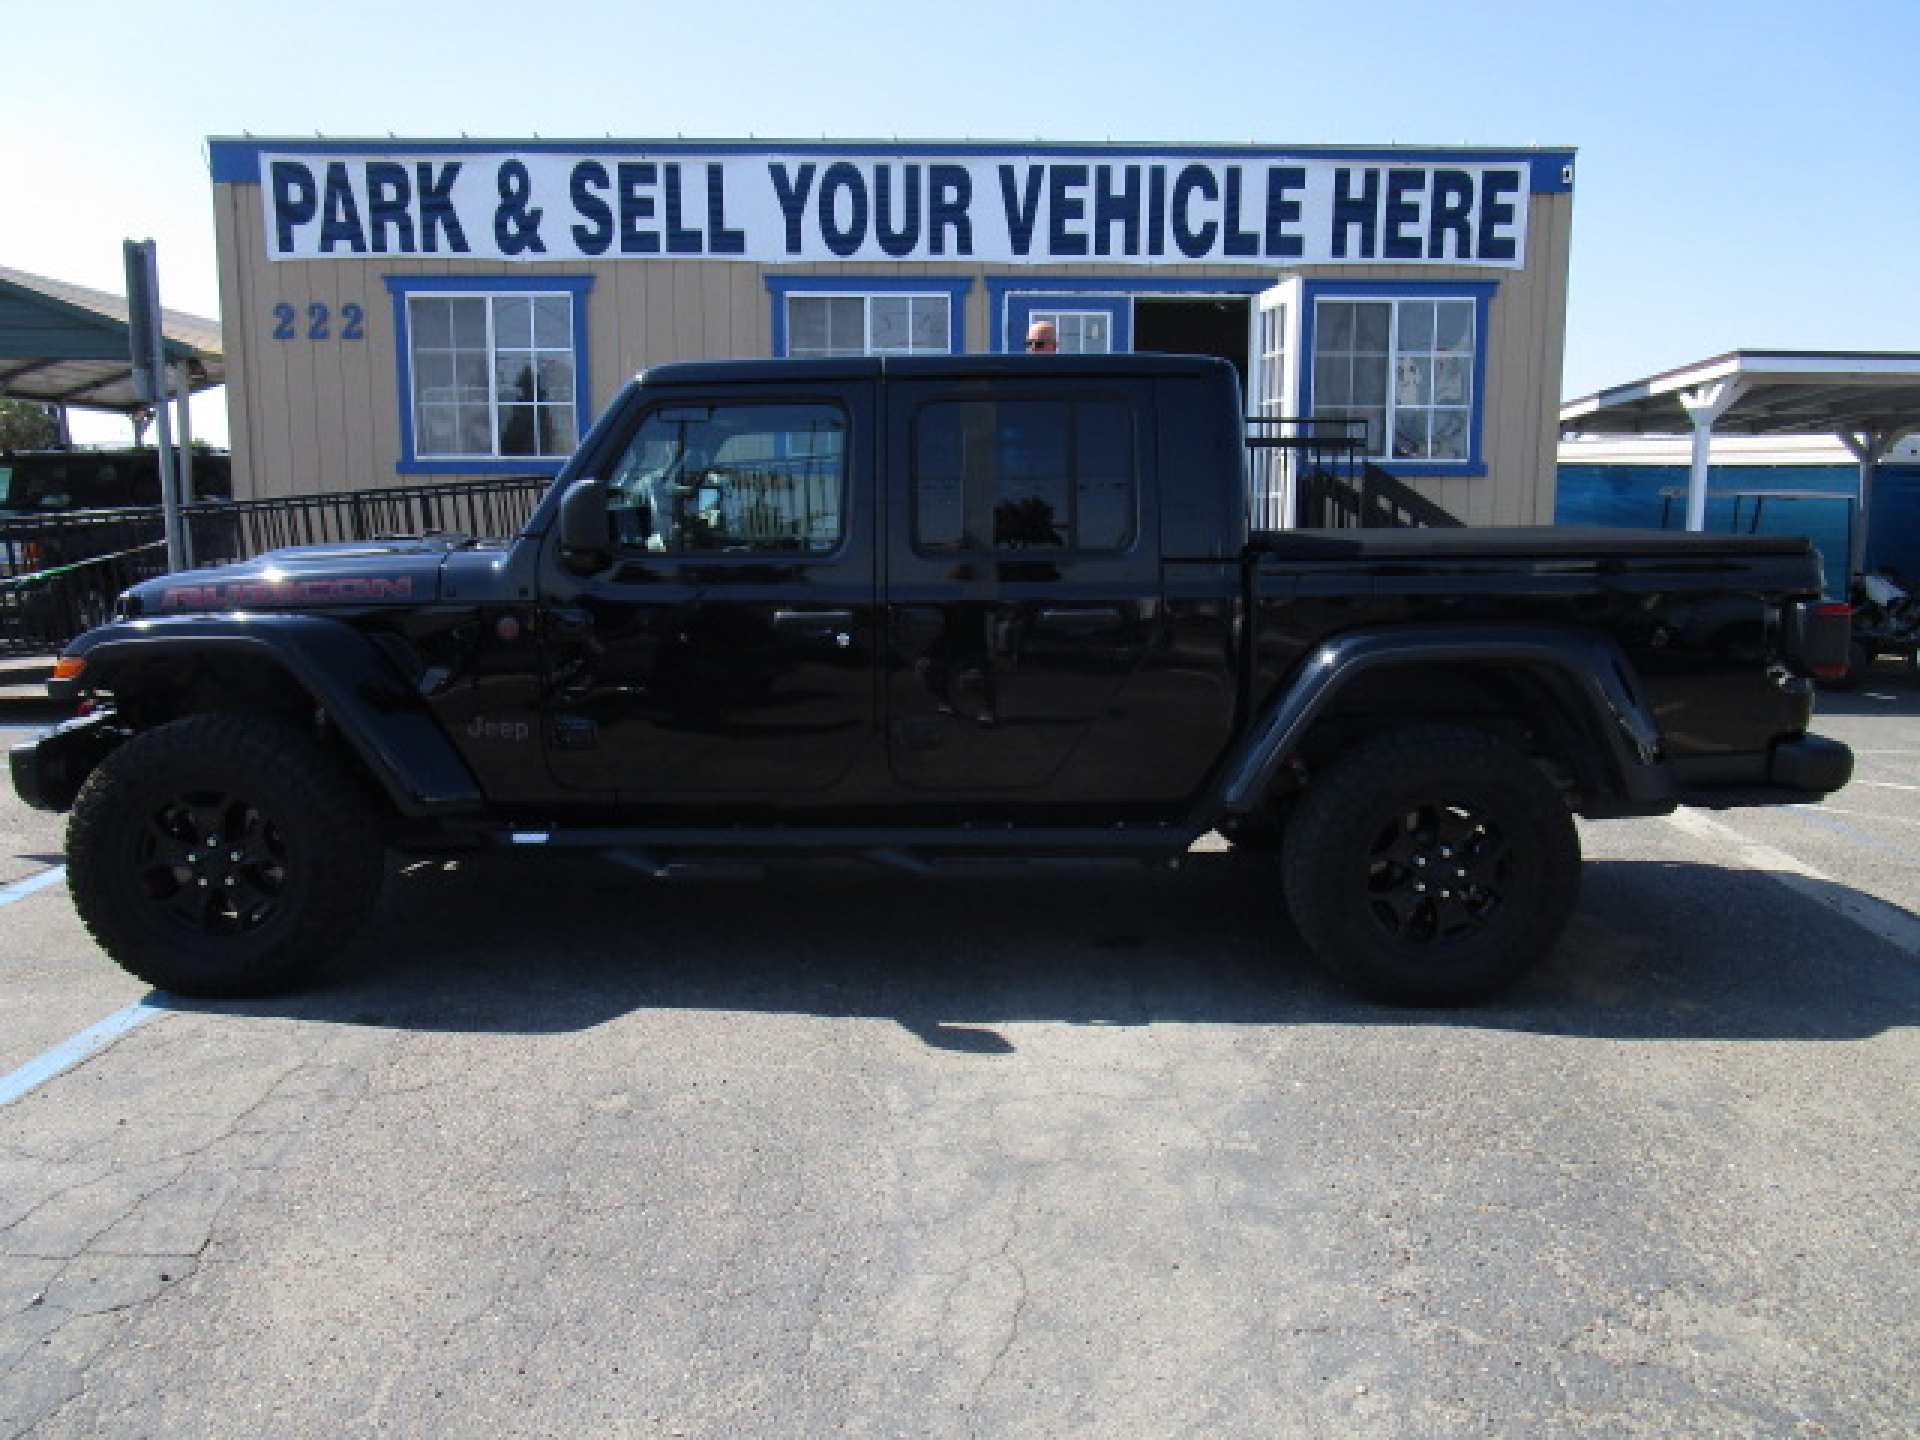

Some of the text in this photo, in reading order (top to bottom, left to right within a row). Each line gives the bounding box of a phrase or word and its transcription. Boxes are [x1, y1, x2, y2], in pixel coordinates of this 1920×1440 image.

[270, 159, 1521, 259] PARK & SELL YOUR VEHICLE HERE
[273, 303, 365, 340] 222
[467, 715, 529, 742] Jeep
